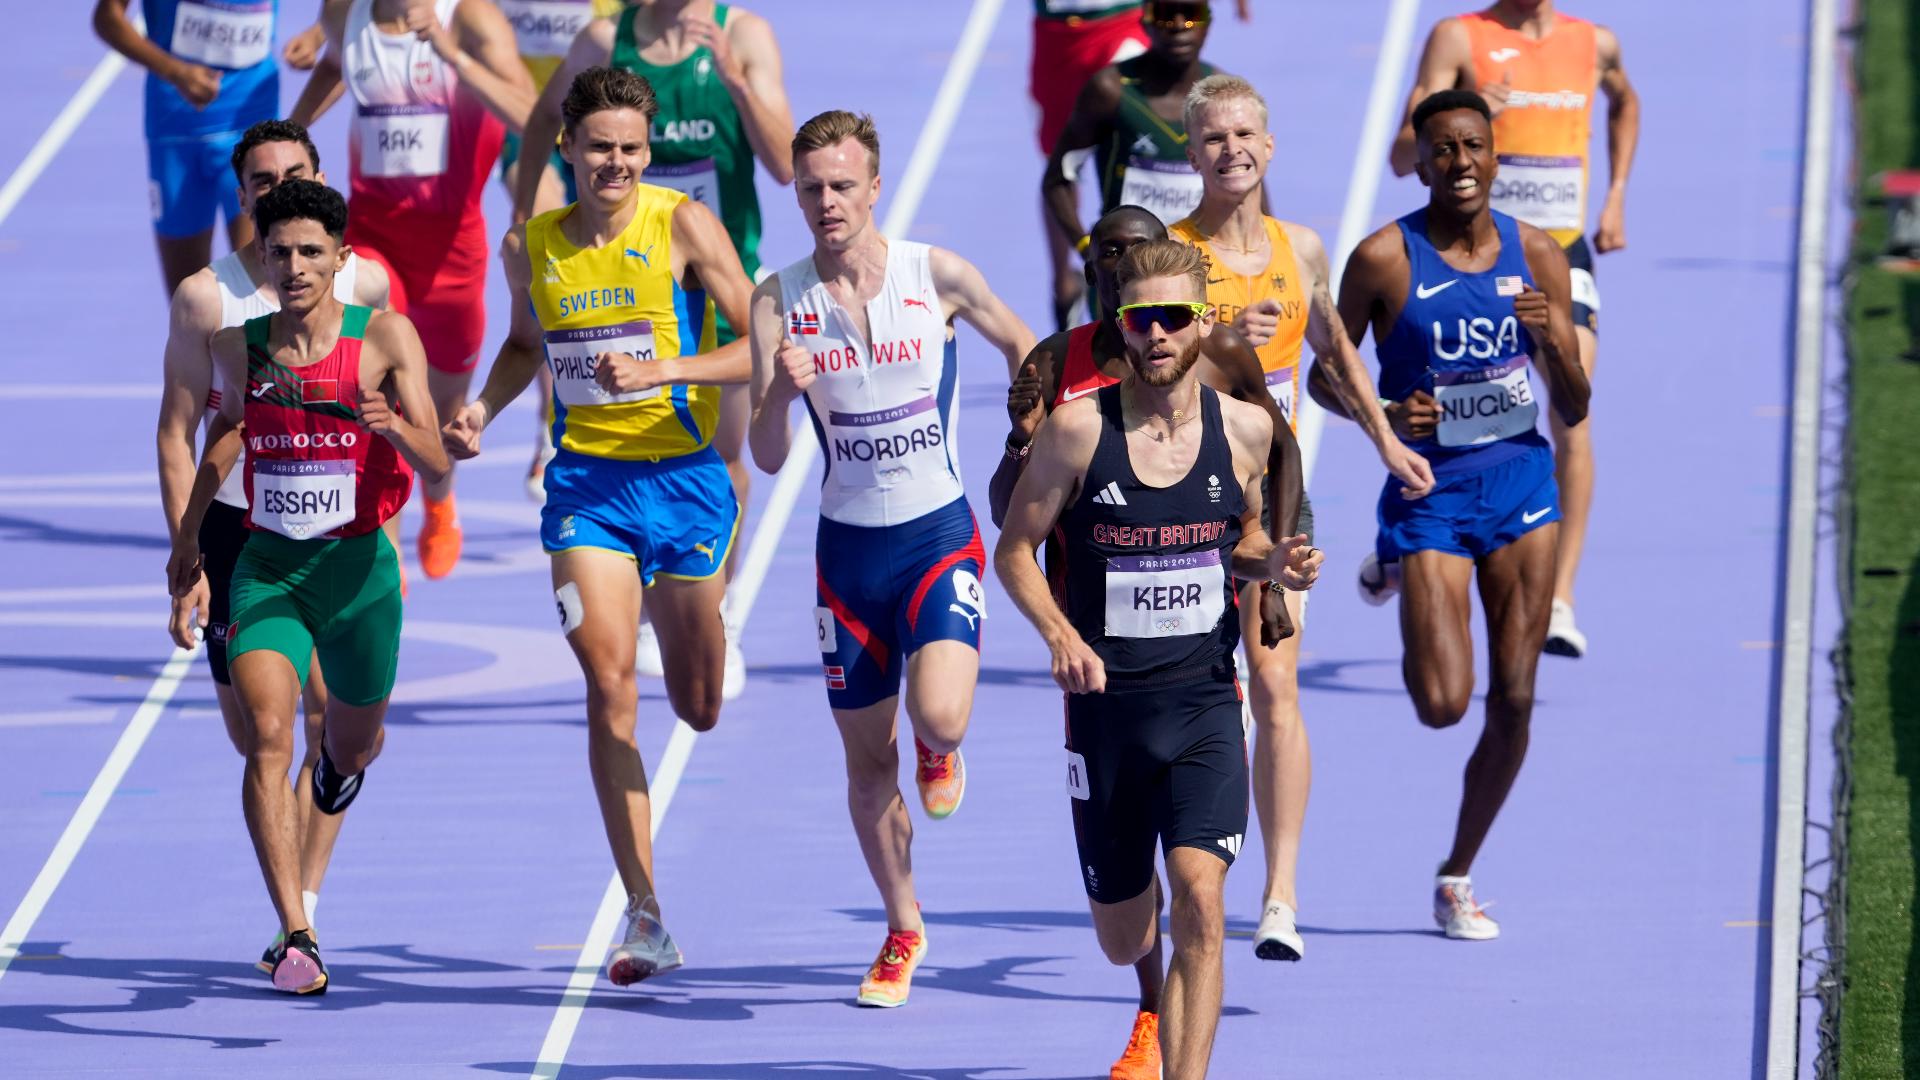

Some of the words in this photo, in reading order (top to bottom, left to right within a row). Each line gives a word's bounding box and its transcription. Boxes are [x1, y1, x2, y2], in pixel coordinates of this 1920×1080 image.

[377, 128, 423, 152] RAK
[649, 119, 716, 143] LAND
[559, 287, 636, 318] SWEDEN
[568, 331, 595, 340] PARIS
[596, 327, 623, 338] 2024
[1432, 316, 1518, 361] USA
[554, 348, 653, 380] PIHLSM
[813, 338, 922, 375] NORWAY
[1442, 380, 1530, 422] NUGUSE
[854, 414, 882, 425] PARIS
[884, 408, 910, 420] 2024
[249, 432, 357, 451] MOROCCO
[835, 423, 941, 462] NORDAS
[271, 464, 296, 473] PARIS
[298, 464, 326, 473] 2024
[264, 489, 340, 515] ESSAYI
[1093, 524, 1157, 547] GREAT
[1160, 520, 1228, 547] BRITAIN
[1139, 559, 1169, 568] PARIS
[1171, 557, 1197, 567] 2024
[968, 582, 980, 602] 6
[1133, 583, 1202, 611] KERR
[557, 600, 567, 627] 3
[818, 617, 827, 641] 6
